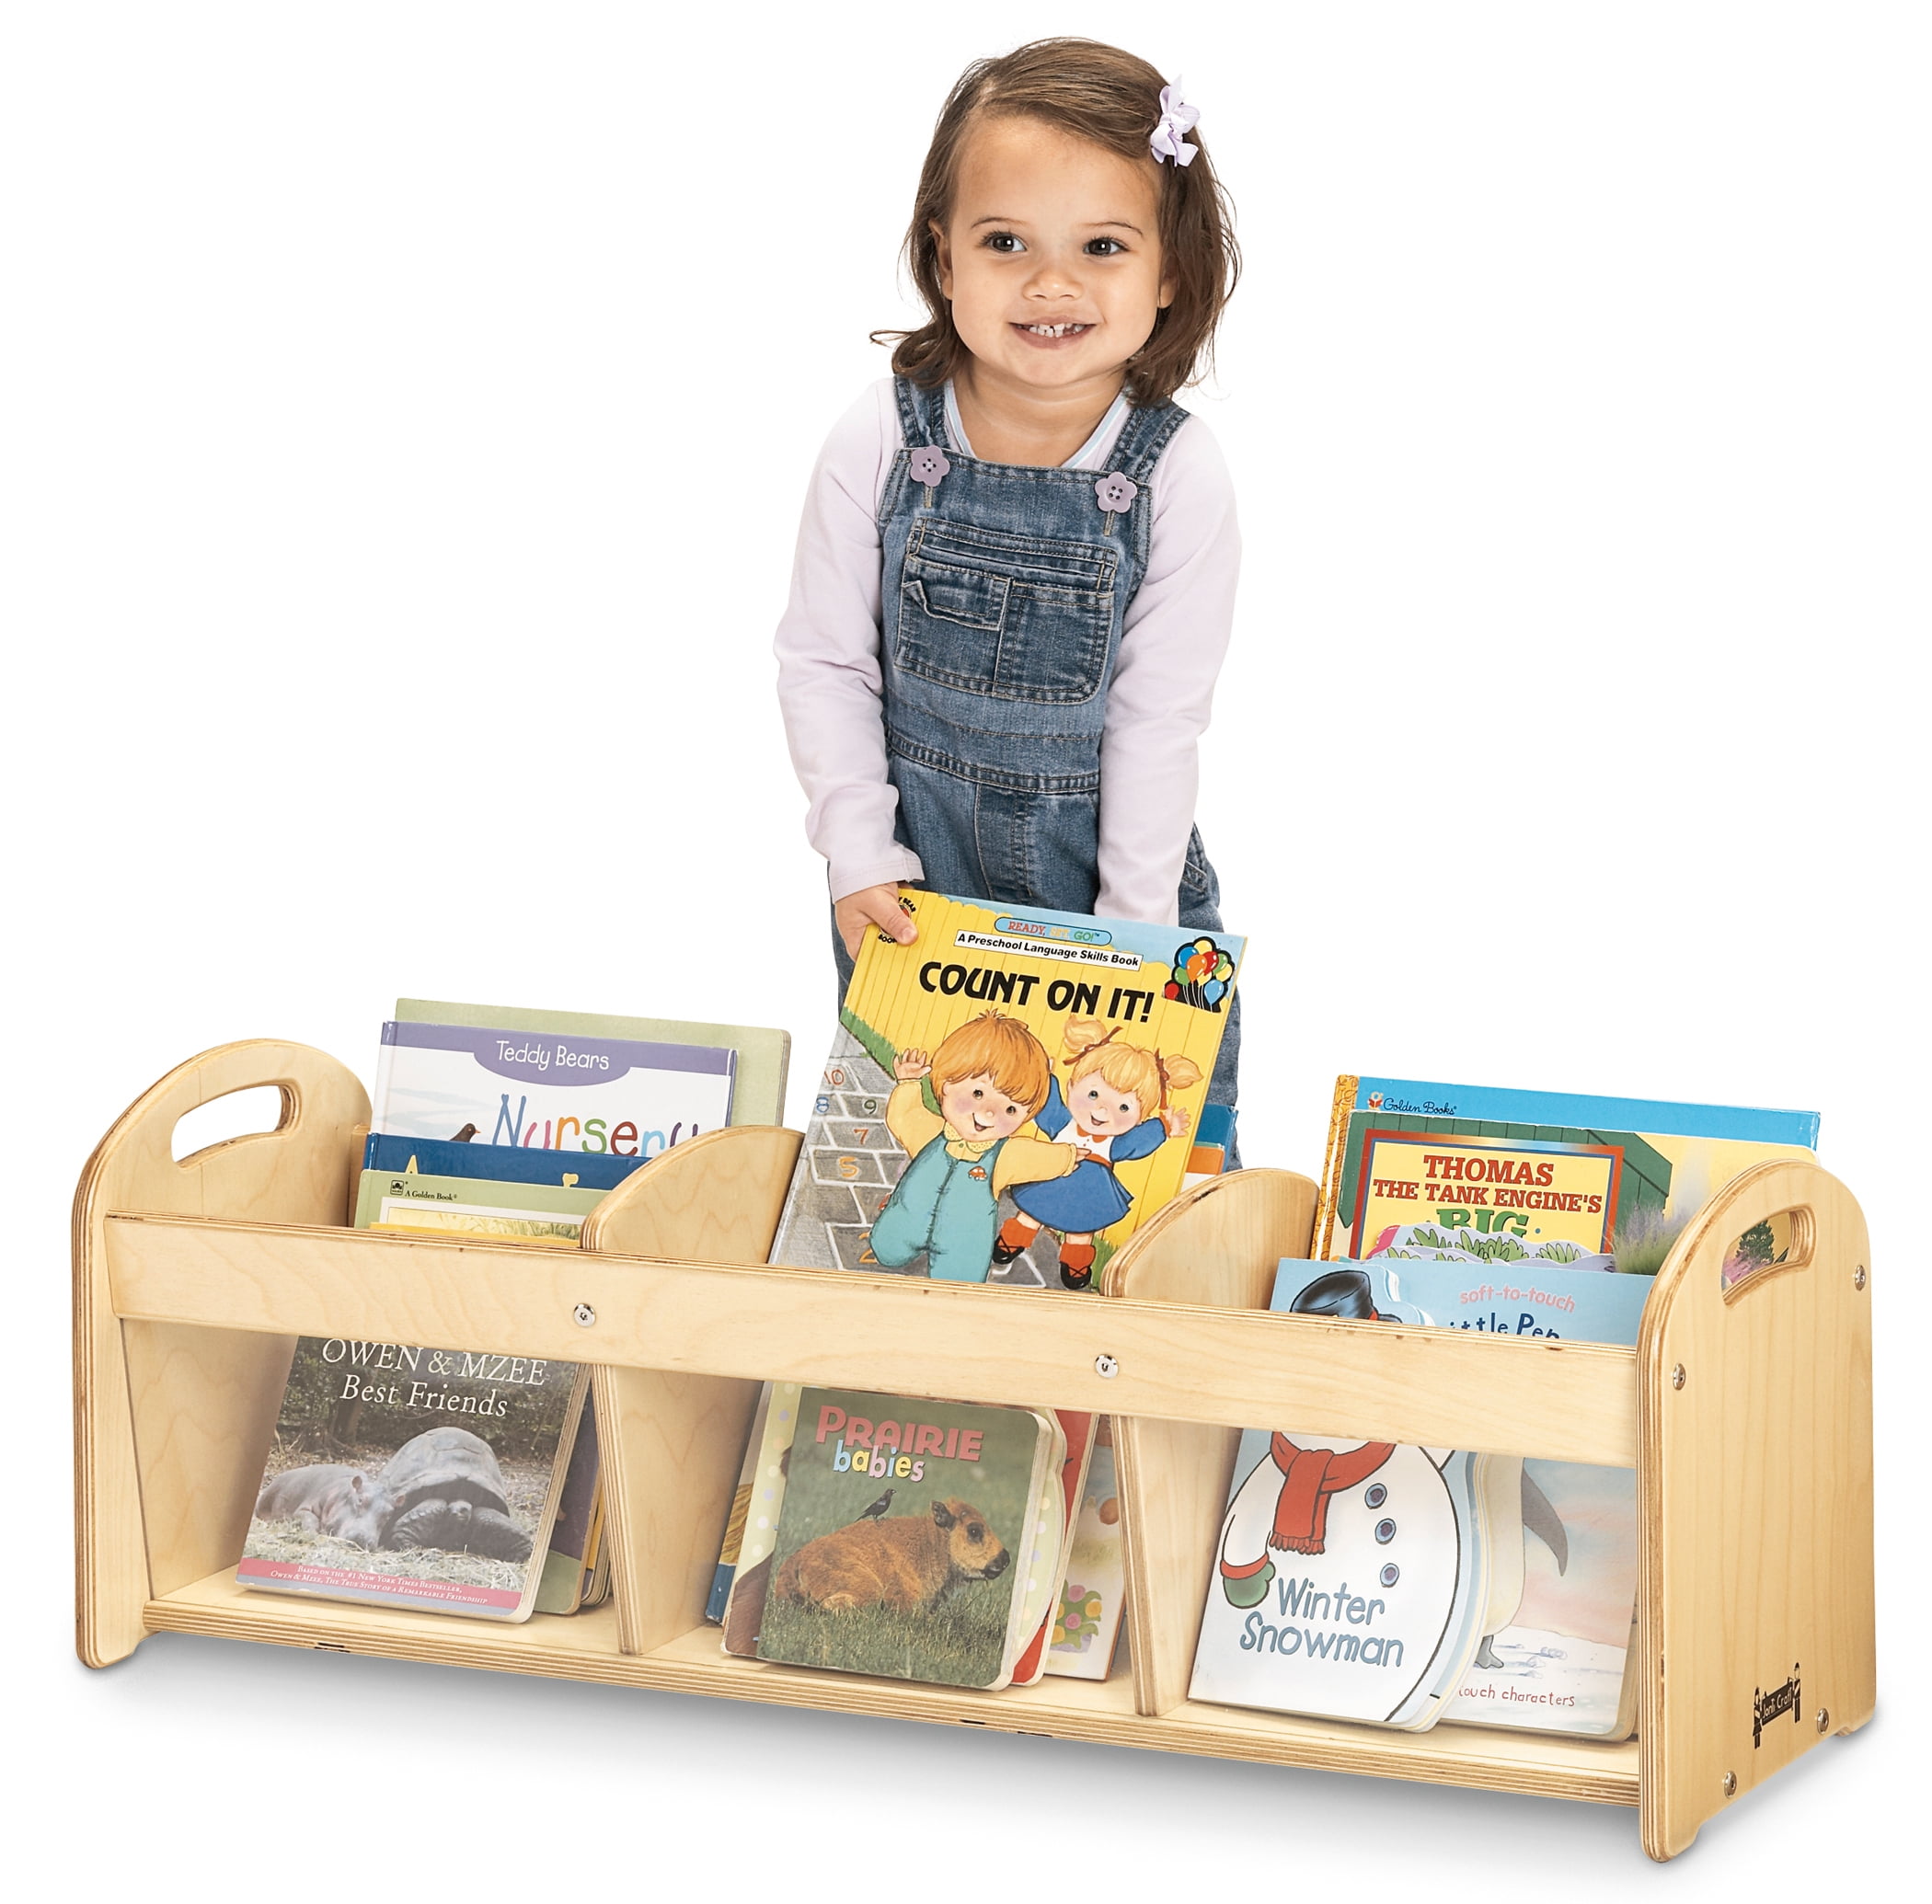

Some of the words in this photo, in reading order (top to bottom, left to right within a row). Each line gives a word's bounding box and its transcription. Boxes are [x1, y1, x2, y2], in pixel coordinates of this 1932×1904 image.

[1007, 921, 1046, 936] READY,
[958, 933, 965, 943] A
[968, 935, 1022, 950] Preschool
[1024, 942, 1078, 958] Language
[1080, 950, 1109, 962] Skills
[1111, 955, 1139, 967] Book
[919, 961, 1040, 1006] COUNT
[1047, 980, 1101, 1015] ON
[1107, 988, 1155, 1023] IT!
[496, 1040, 551, 1072] Teddy
[556, 1045, 610, 1070] Bears
[824, 1069, 845, 1085] 10
[816, 1096, 829, 1113] 8
[863, 1099, 878, 1115] 9
[1383, 1097, 1421, 1113] Golden
[1422, 1101, 1455, 1116] Books
[853, 1128, 869, 1145] 7
[838, 1155, 859, 1178] 5
[1423, 1154, 1555, 1187] THOMAS
[405, 1189, 410, 1198] A
[411, 1190, 435, 1199] Golden
[1373, 1178, 1420, 1200] THE
[1425, 1183, 1490, 1206] TANK
[1493, 1188, 1603, 1213] ENGINE'S
[1460, 1285, 1576, 1313] soft-to-touch
[322, 1338, 423, 1371] OWEN
[428, 1350, 453, 1375] &
[457, 1351, 547, 1386] MZEE
[339, 1373, 398, 1405] Best
[407, 1381, 508, 1417] Friends
[815, 1405, 984, 1462] PRAIRIE
[833, 1439, 926, 1483] babies
[1278, 1577, 1386, 1625] Winter
[1240, 1611, 1404, 1668] Snowman
[1501, 1685, 1575, 1707] characters
